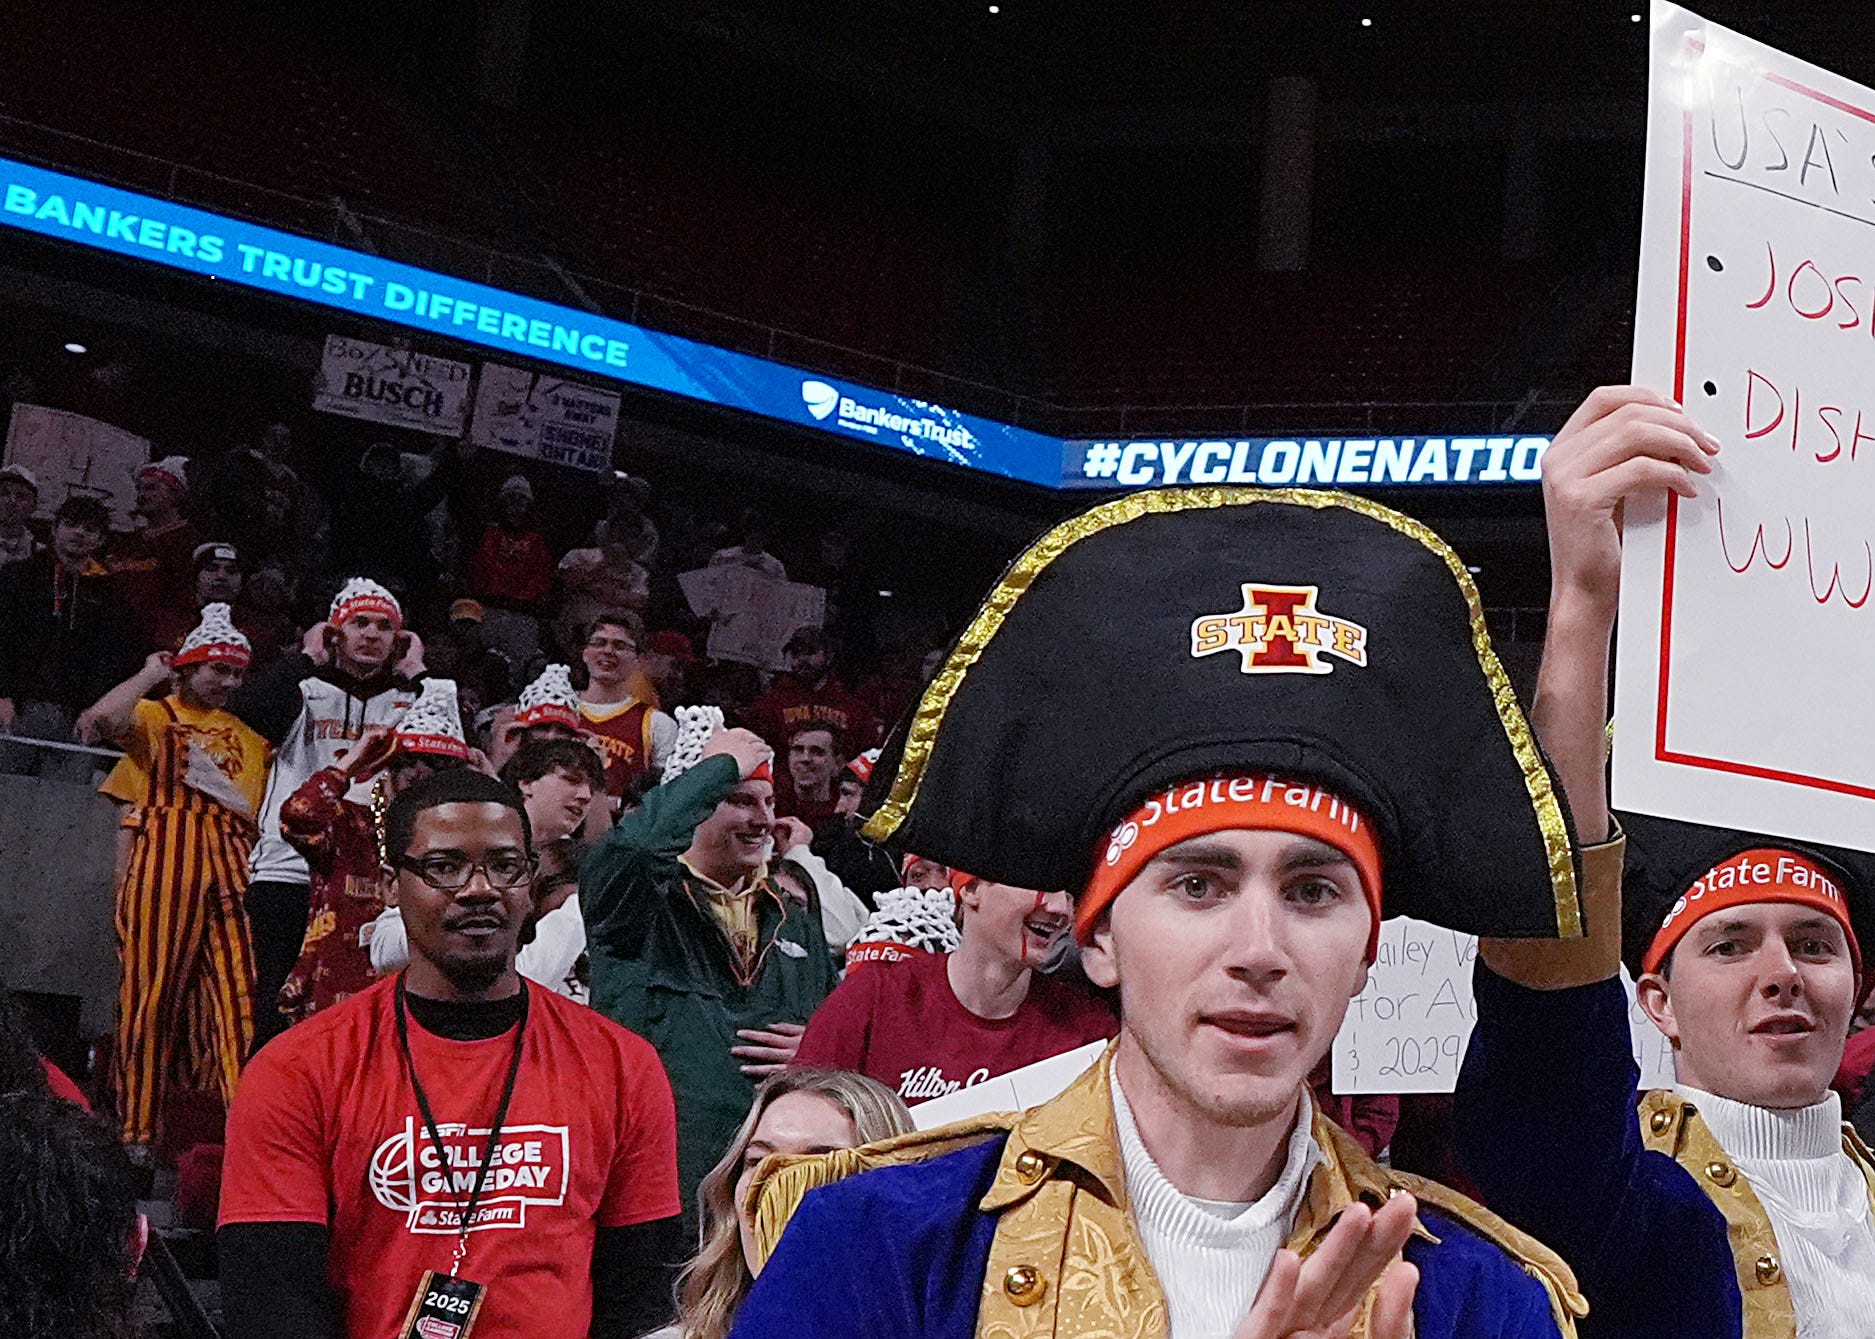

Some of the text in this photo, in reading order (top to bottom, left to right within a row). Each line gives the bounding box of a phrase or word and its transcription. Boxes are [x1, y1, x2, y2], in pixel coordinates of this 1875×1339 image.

[5, 184, 630, 368] BANKERS TRUST DIFFERENCE
[344, 372, 443, 417] BUSCH
[1196, 614, 1362, 662] STATE
[880, 947, 913, 962] Far
[1376, 925, 1435, 976] ailey
[1379, 1035, 1461, 1077] 2029
[897, 1067, 961, 1099] Hilton
[439, 1210, 476, 1226] Stae
[425, 1292, 470, 1314] 2025
